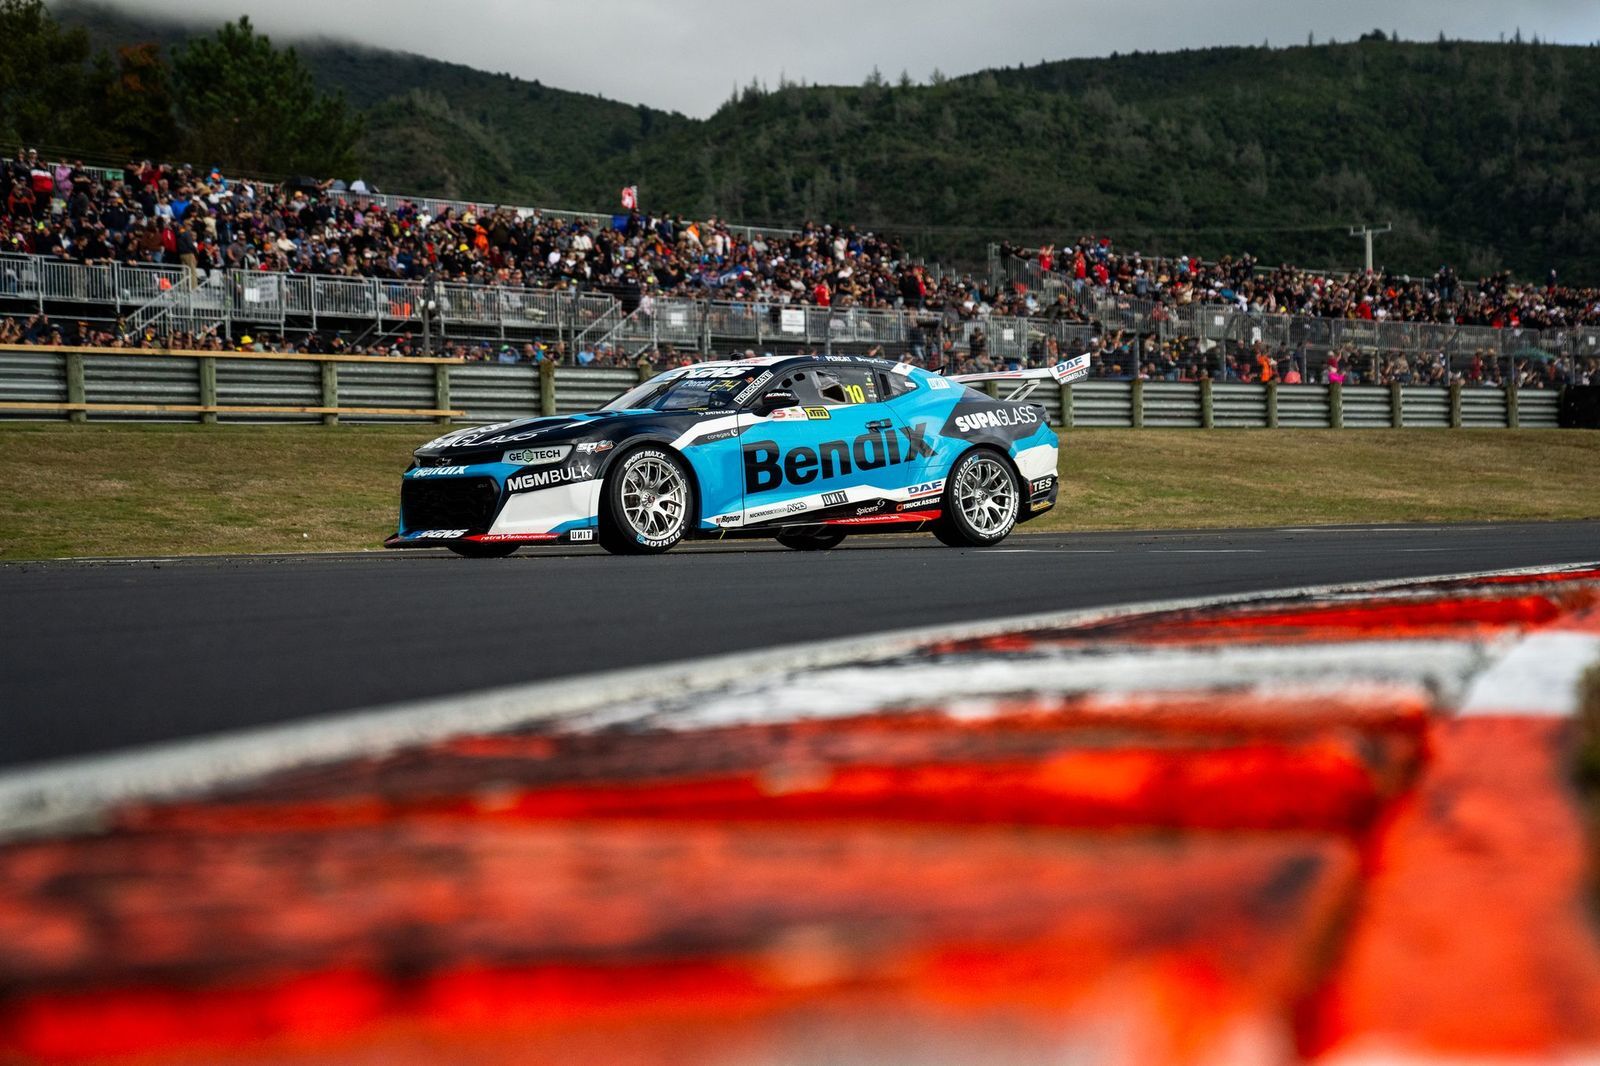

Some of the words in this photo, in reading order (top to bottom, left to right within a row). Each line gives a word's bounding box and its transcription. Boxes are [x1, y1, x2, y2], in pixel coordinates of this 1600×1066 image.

[1057, 357, 1083, 373] DAF
[1060, 369, 1088, 384] MGMBULK
[737, 369, 771, 403] TRUCKMATE
[845, 385, 865, 403] 10
[955, 406, 1037, 433] SUPAGLASS
[624, 451, 645, 470] SPORT
[644, 450, 666, 460] MAXX
[742, 422, 937, 494] Bendix
[507, 464, 593, 492] MGMBULK
[953, 456, 974, 497] DUNLOP
[1032, 477, 1053, 492] TES
[907, 481, 942, 494] DAF
[571, 531, 592, 540] UNIT
[643, 530, 681, 547] DUNLOP
